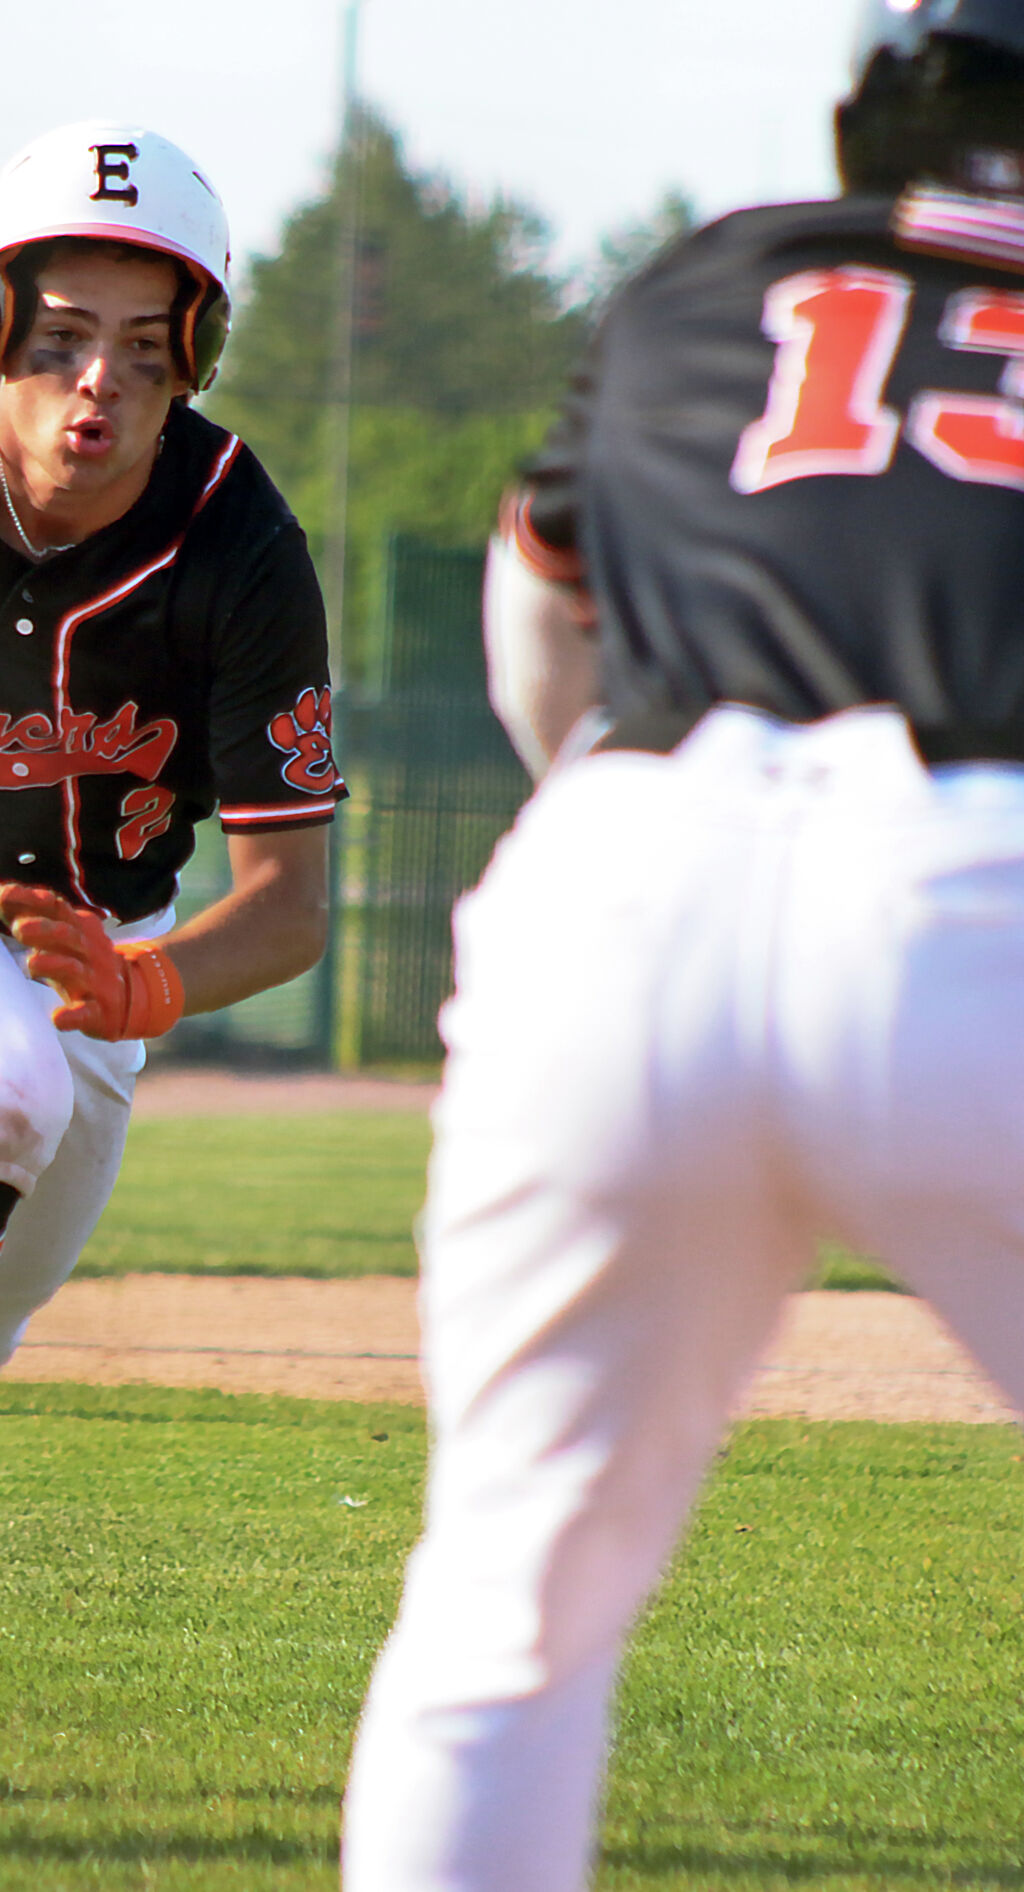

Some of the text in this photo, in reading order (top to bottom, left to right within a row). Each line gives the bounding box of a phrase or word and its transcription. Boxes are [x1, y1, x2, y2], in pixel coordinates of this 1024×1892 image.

[87, 141, 140, 208] E
[728, 262, 1024, 495] 13
[116, 783, 176, 861] 2
